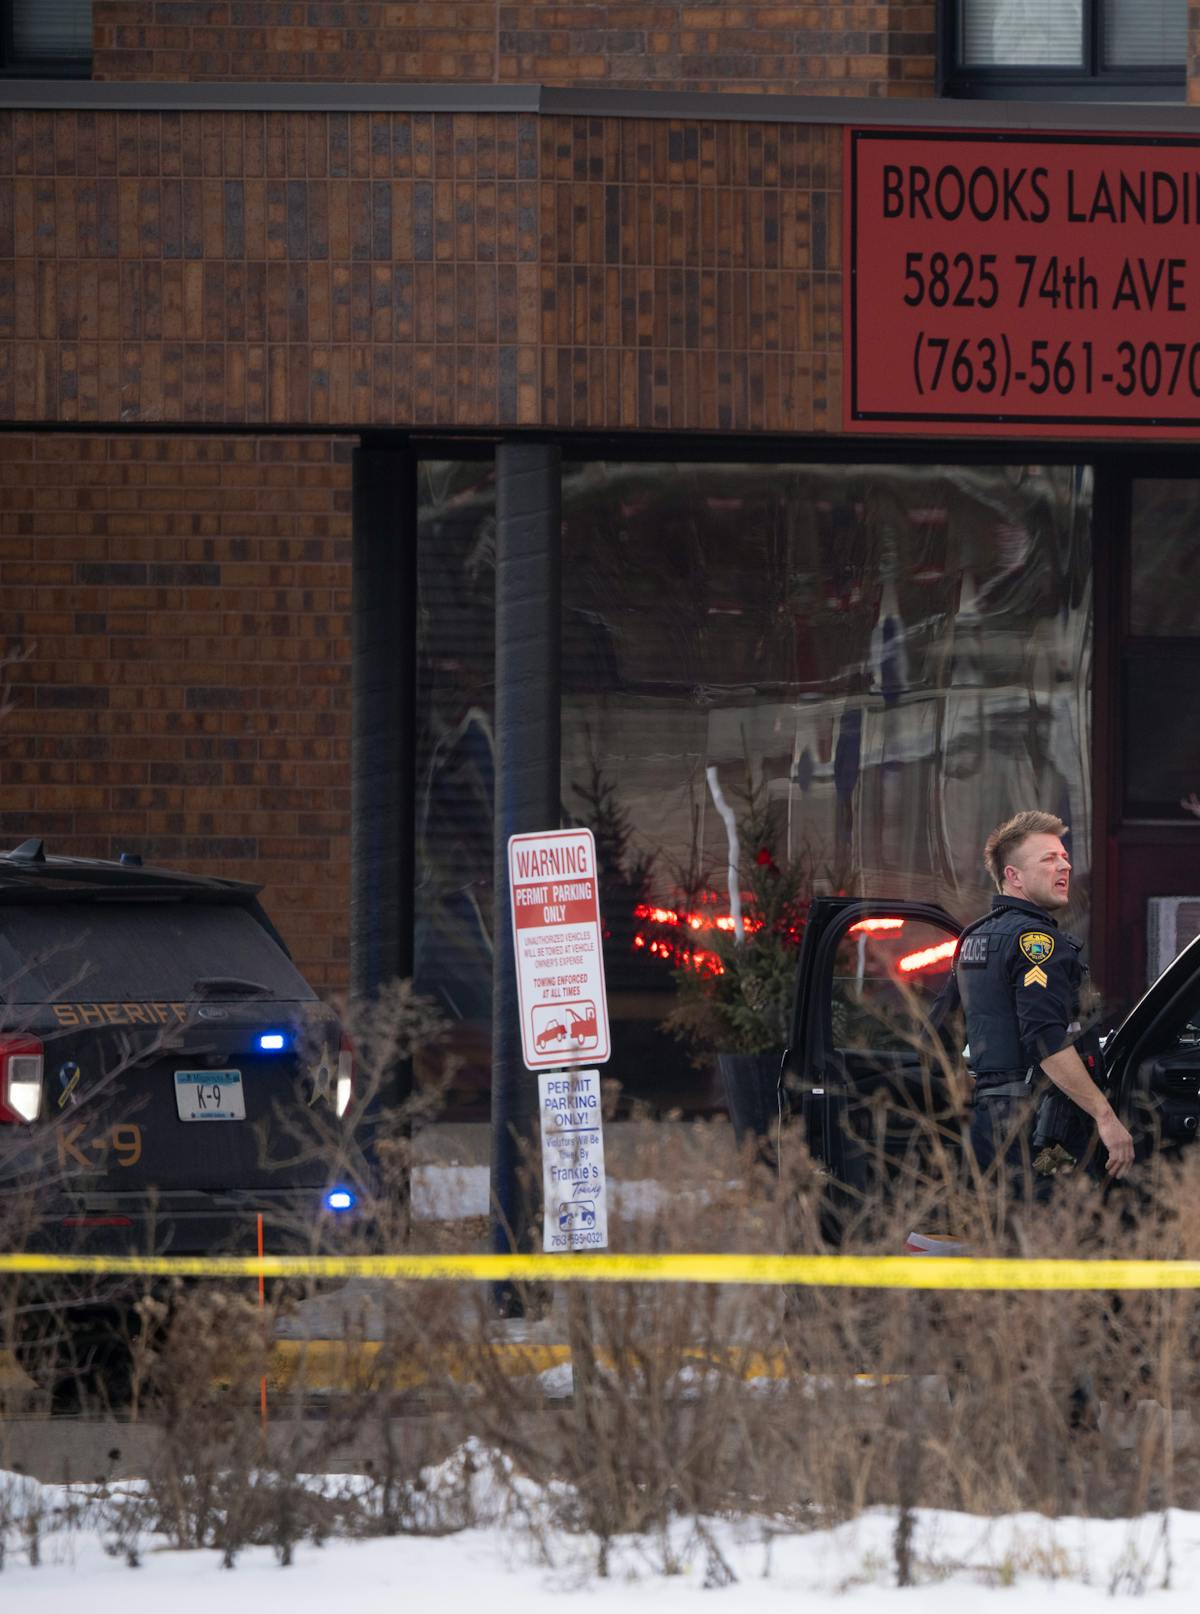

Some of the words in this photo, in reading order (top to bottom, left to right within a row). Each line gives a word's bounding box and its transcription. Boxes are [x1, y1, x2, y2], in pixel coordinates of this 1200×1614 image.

[883, 165, 1050, 223] BROOKS
[903, 252, 999, 308] 5825
[1015, 256, 1099, 310] 74th
[1112, 258, 1187, 312] AVE
[516, 845, 587, 878] WARNING
[516, 887, 549, 906] PERMIT
[552, 882, 592, 902] PARKING
[543, 905, 566, 923] ONLY
[566, 931, 591, 942] VEHICLES
[537, 947, 545, 956] BE
[572, 942, 594, 953] VEHICLE
[560, 955, 583, 966] EXPENSE
[534, 976, 556, 988] TOWING
[557, 973, 588, 986] ENFORCED
[543, 988, 550, 998] AT
[551, 987, 561, 997] ALL
[562, 986, 580, 997] TIMES
[52, 1003, 187, 1024] SHERIFF
[196, 1084, 221, 1109] K-9
[544, 1095, 597, 1110] PARKING
[554, 1112, 589, 1126] ONLY!
[56, 1123, 142, 1169] K-9
[551, 1163, 599, 1181] Frankie's
